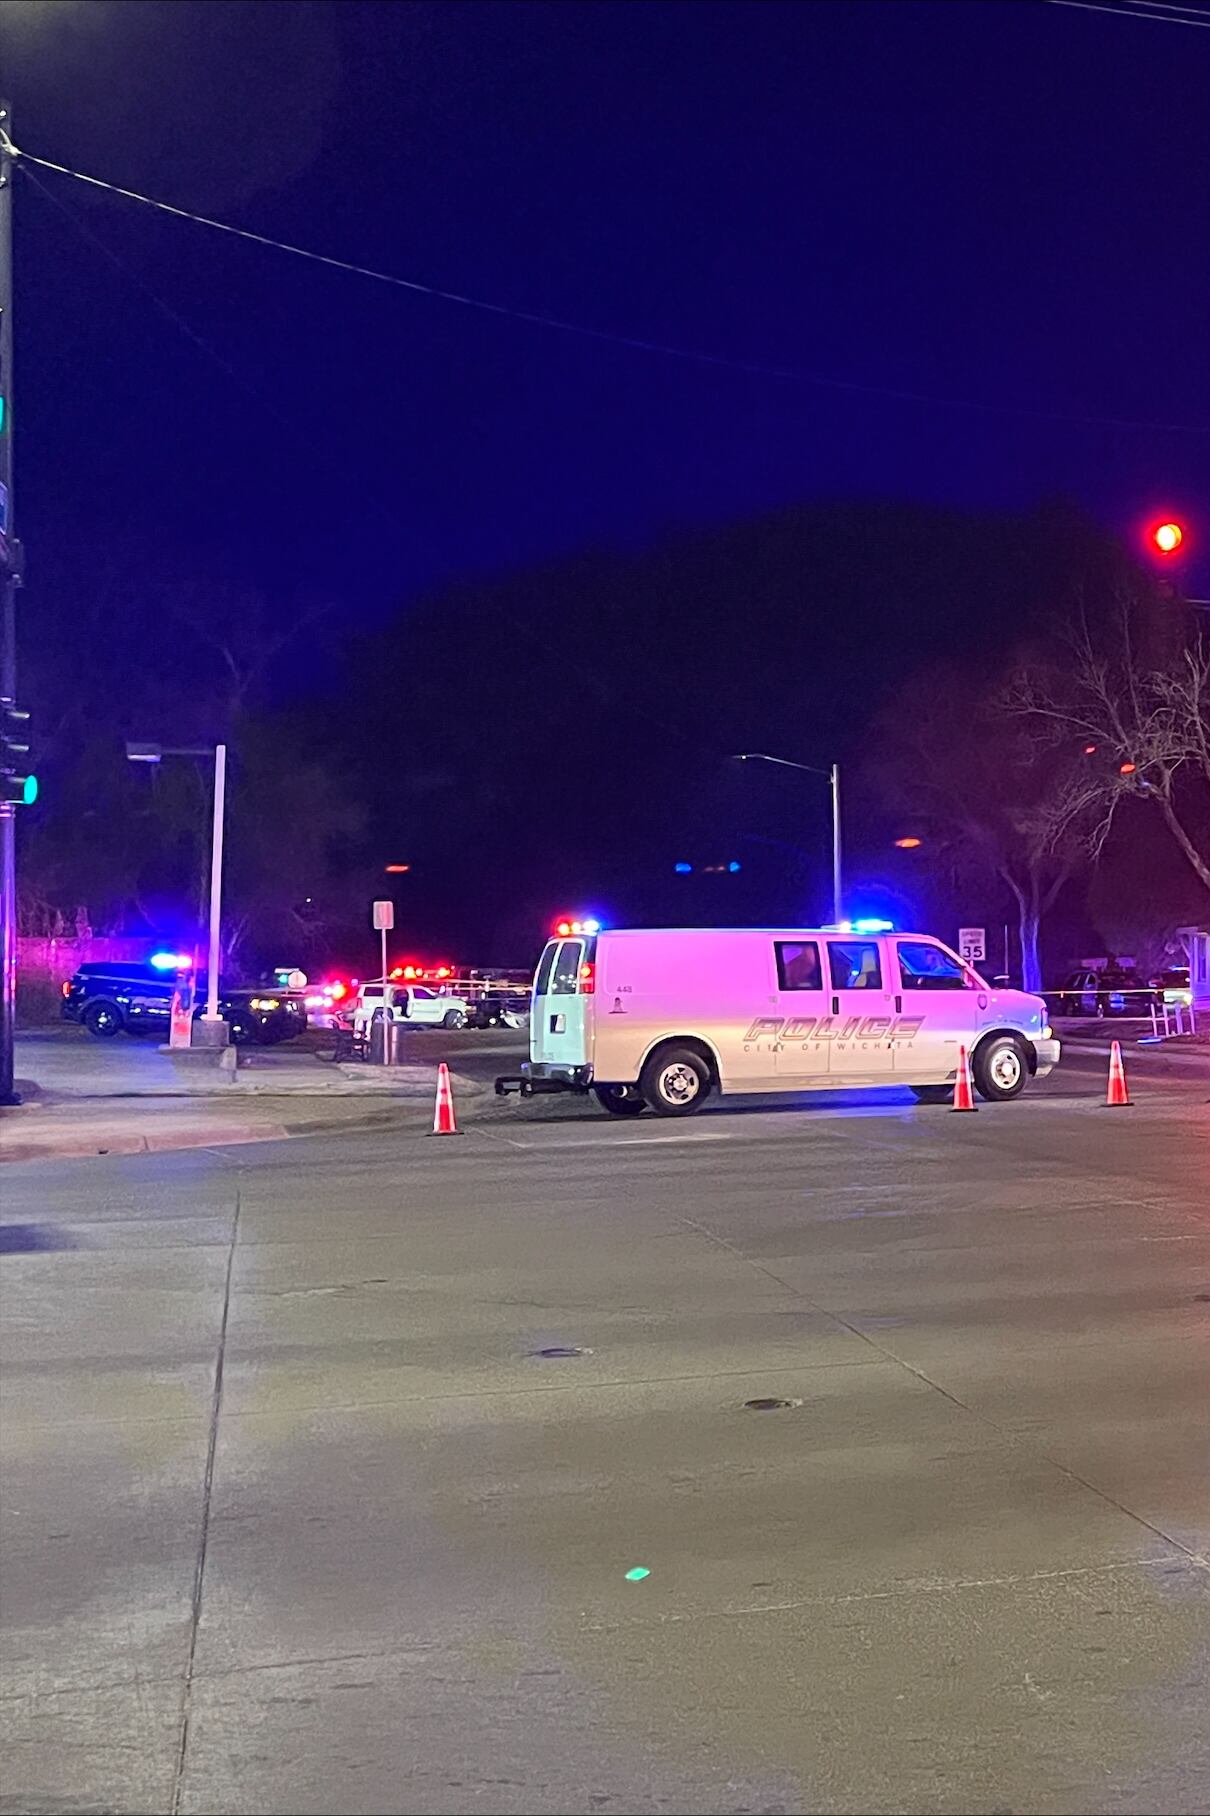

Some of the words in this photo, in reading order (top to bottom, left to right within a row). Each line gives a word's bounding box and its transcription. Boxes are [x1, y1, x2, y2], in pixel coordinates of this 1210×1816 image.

[963, 946, 983, 958] 35
[743, 1016, 927, 1041] POLICE
[802, 1043, 821, 1051] OF
[837, 1041, 913, 1050] WICHTA
